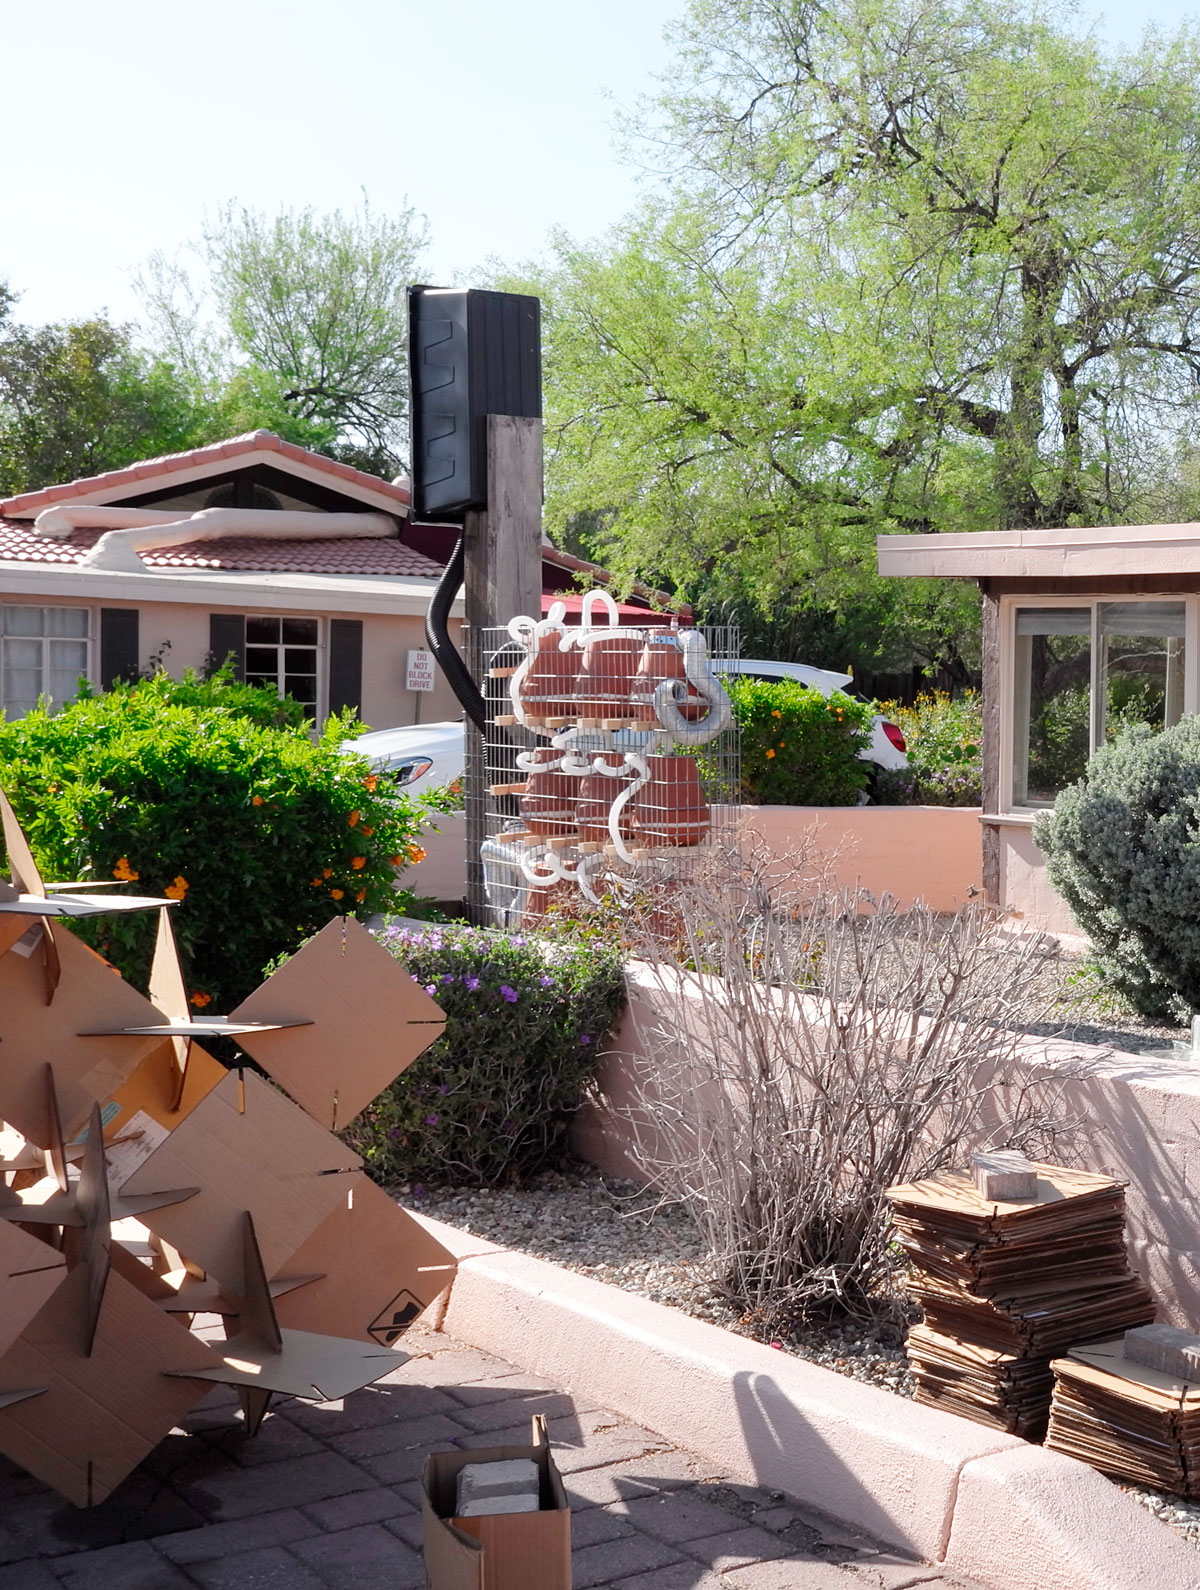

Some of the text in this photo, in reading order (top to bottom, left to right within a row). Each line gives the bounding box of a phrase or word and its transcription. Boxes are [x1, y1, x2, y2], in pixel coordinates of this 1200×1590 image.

[416, 653, 427, 661] DO
[413, 662, 428, 670] NOT
[408, 671, 432, 680] BLOCK
[409, 680, 431, 688] DRIVE
